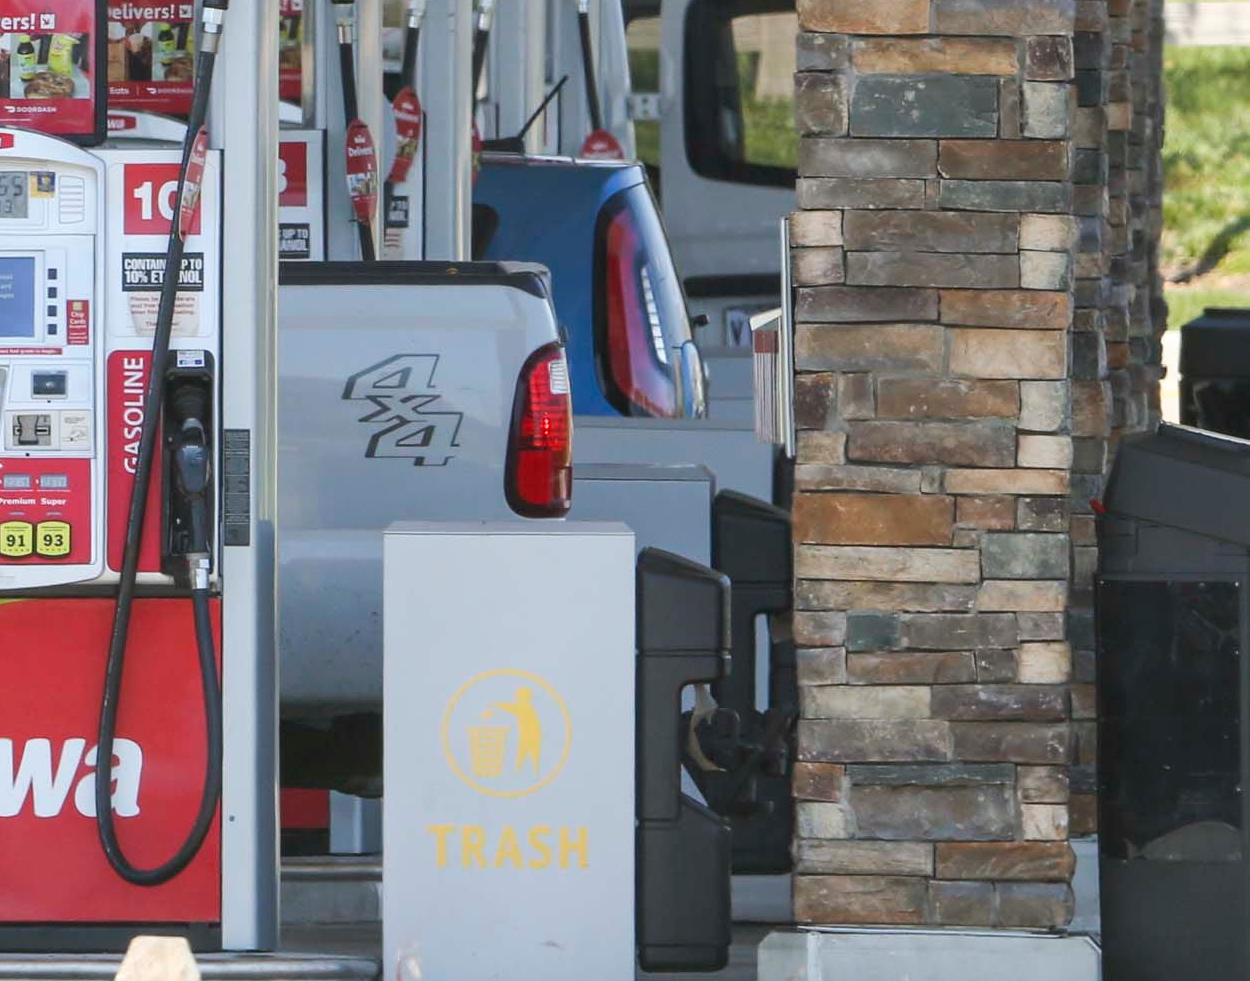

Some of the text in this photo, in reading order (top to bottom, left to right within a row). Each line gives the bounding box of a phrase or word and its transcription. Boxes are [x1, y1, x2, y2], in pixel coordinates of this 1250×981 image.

[125, 258, 167, 269] CONTAIN
[190, 259, 202, 269] TO
[125, 270, 202, 284] 10% ETNOL
[124, 357, 144, 474] GASOLINE
[40, 497, 66, 506] Super
[6, 534, 26, 547] 91
[43, 534, 64, 547] 93
[427, 823, 590, 869] TRASH
